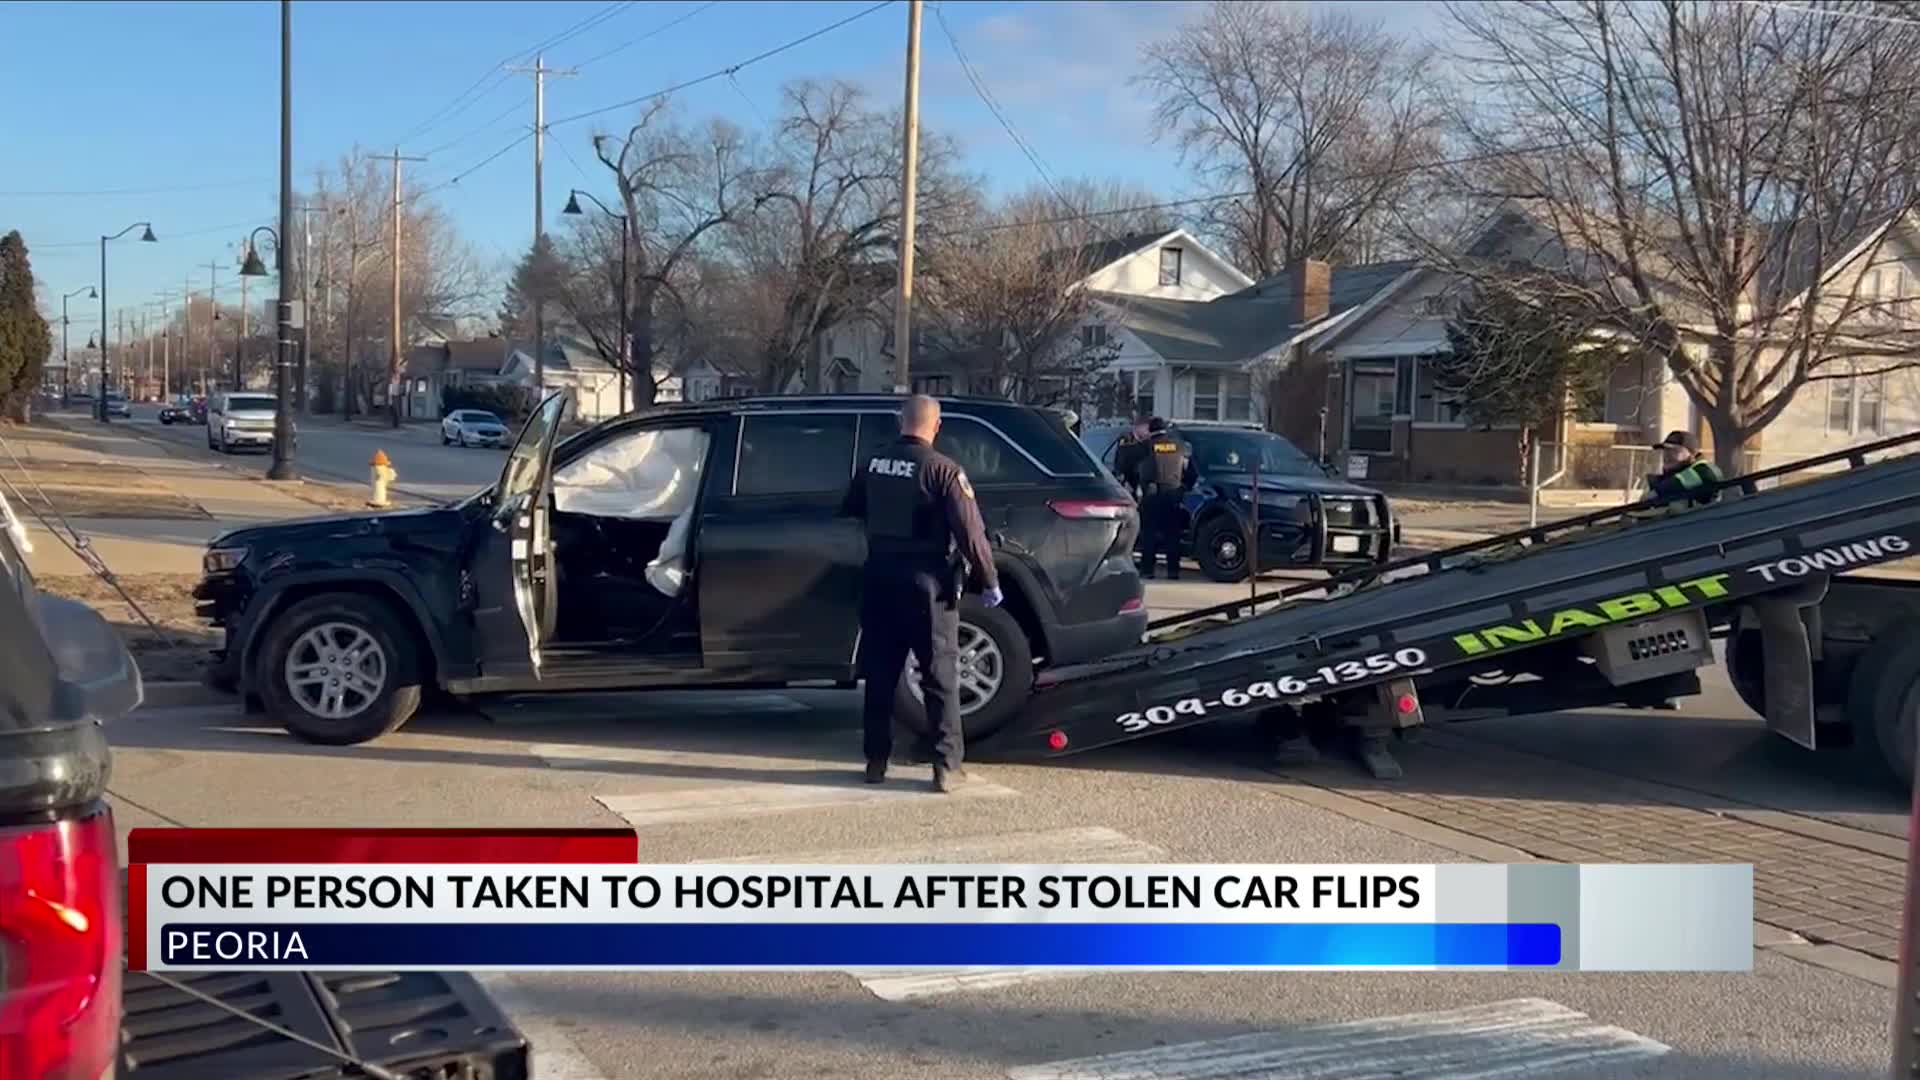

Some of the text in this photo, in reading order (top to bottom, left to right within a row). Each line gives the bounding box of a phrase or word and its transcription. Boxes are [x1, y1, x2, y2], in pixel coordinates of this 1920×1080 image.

[868, 458, 916, 478] POLICE
[1453, 534, 1911, 655] INABIT TOWING
[1115, 647, 1426, 733] 309-696-1350
